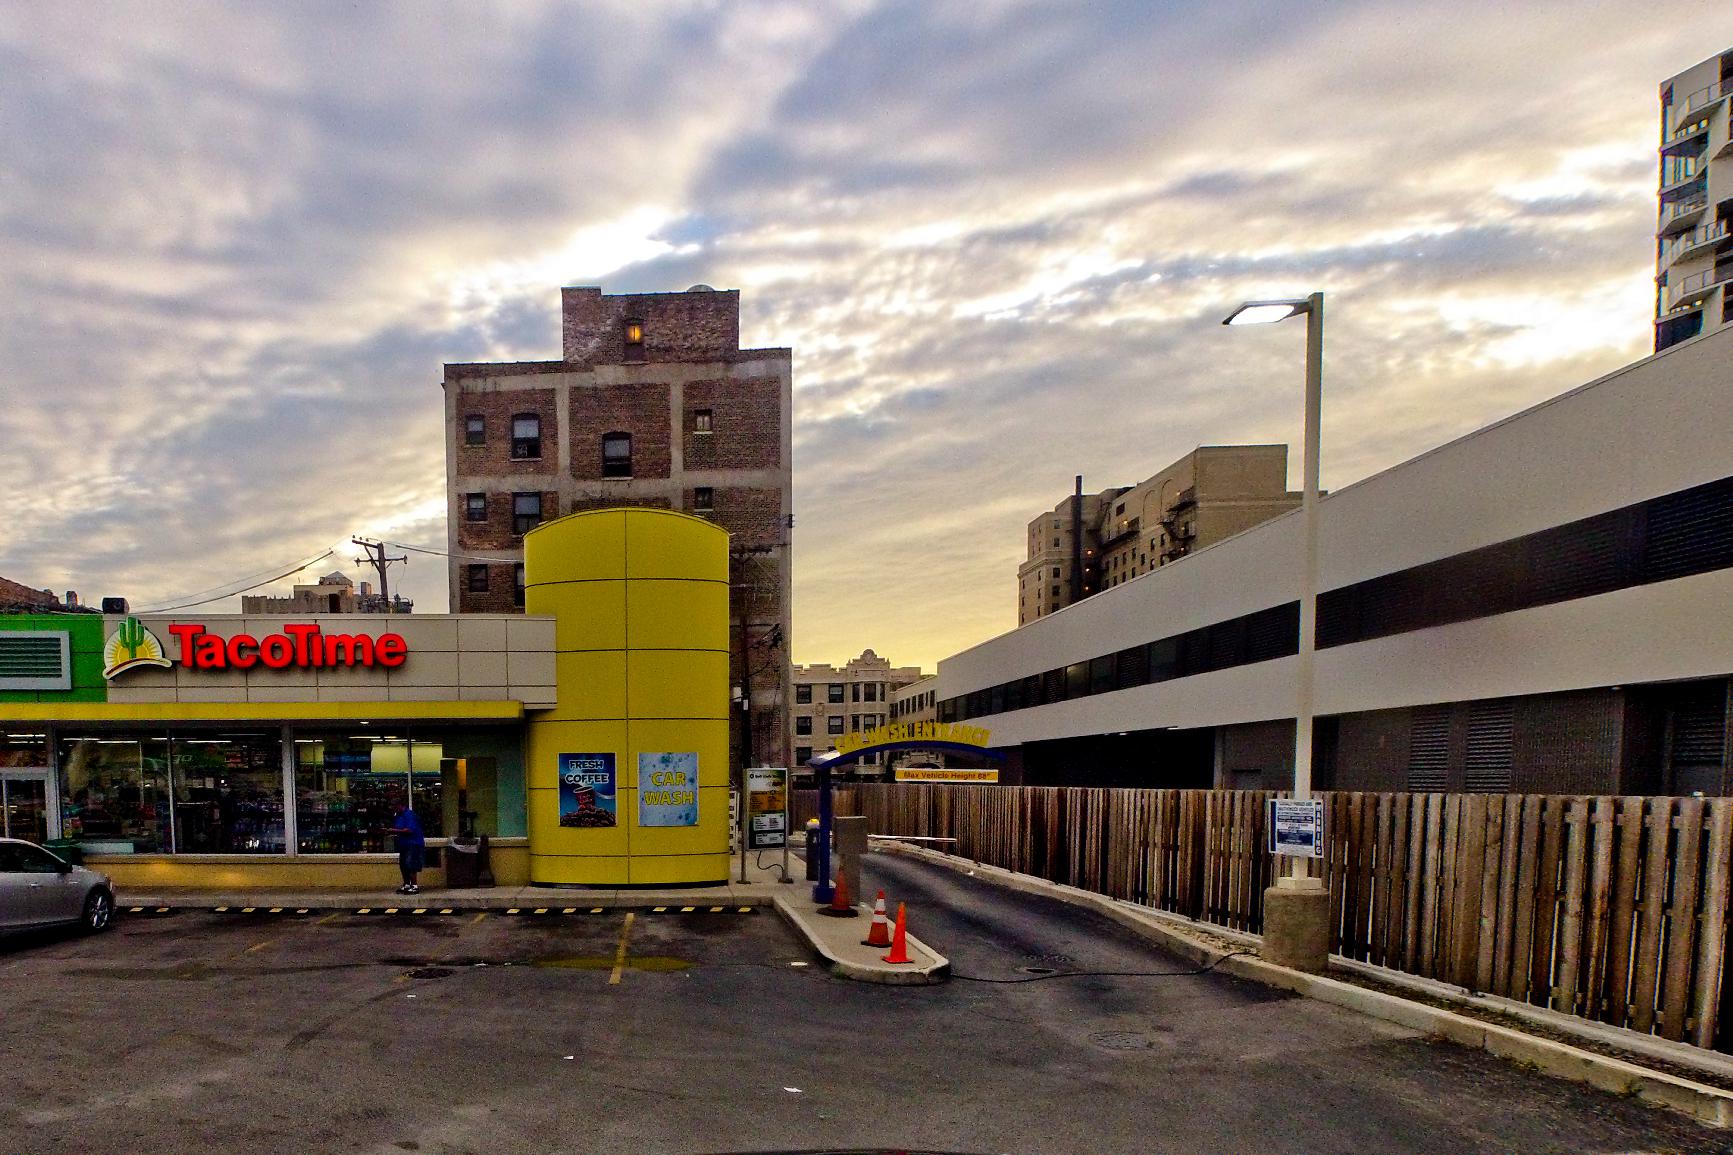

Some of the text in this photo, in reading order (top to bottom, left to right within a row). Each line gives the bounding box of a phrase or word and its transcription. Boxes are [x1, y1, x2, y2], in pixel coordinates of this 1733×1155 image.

[169, 624, 407, 668] TacoTime
[569, 760, 604, 770] FRESH
[565, 773, 609, 784] COFFEE
[651, 771, 686, 786] CAR
[904, 771, 919, 779] Max
[921, 771, 949, 779] Vehicle
[951, 772, 976, 781] Height
[644, 791, 694, 805] WASH
